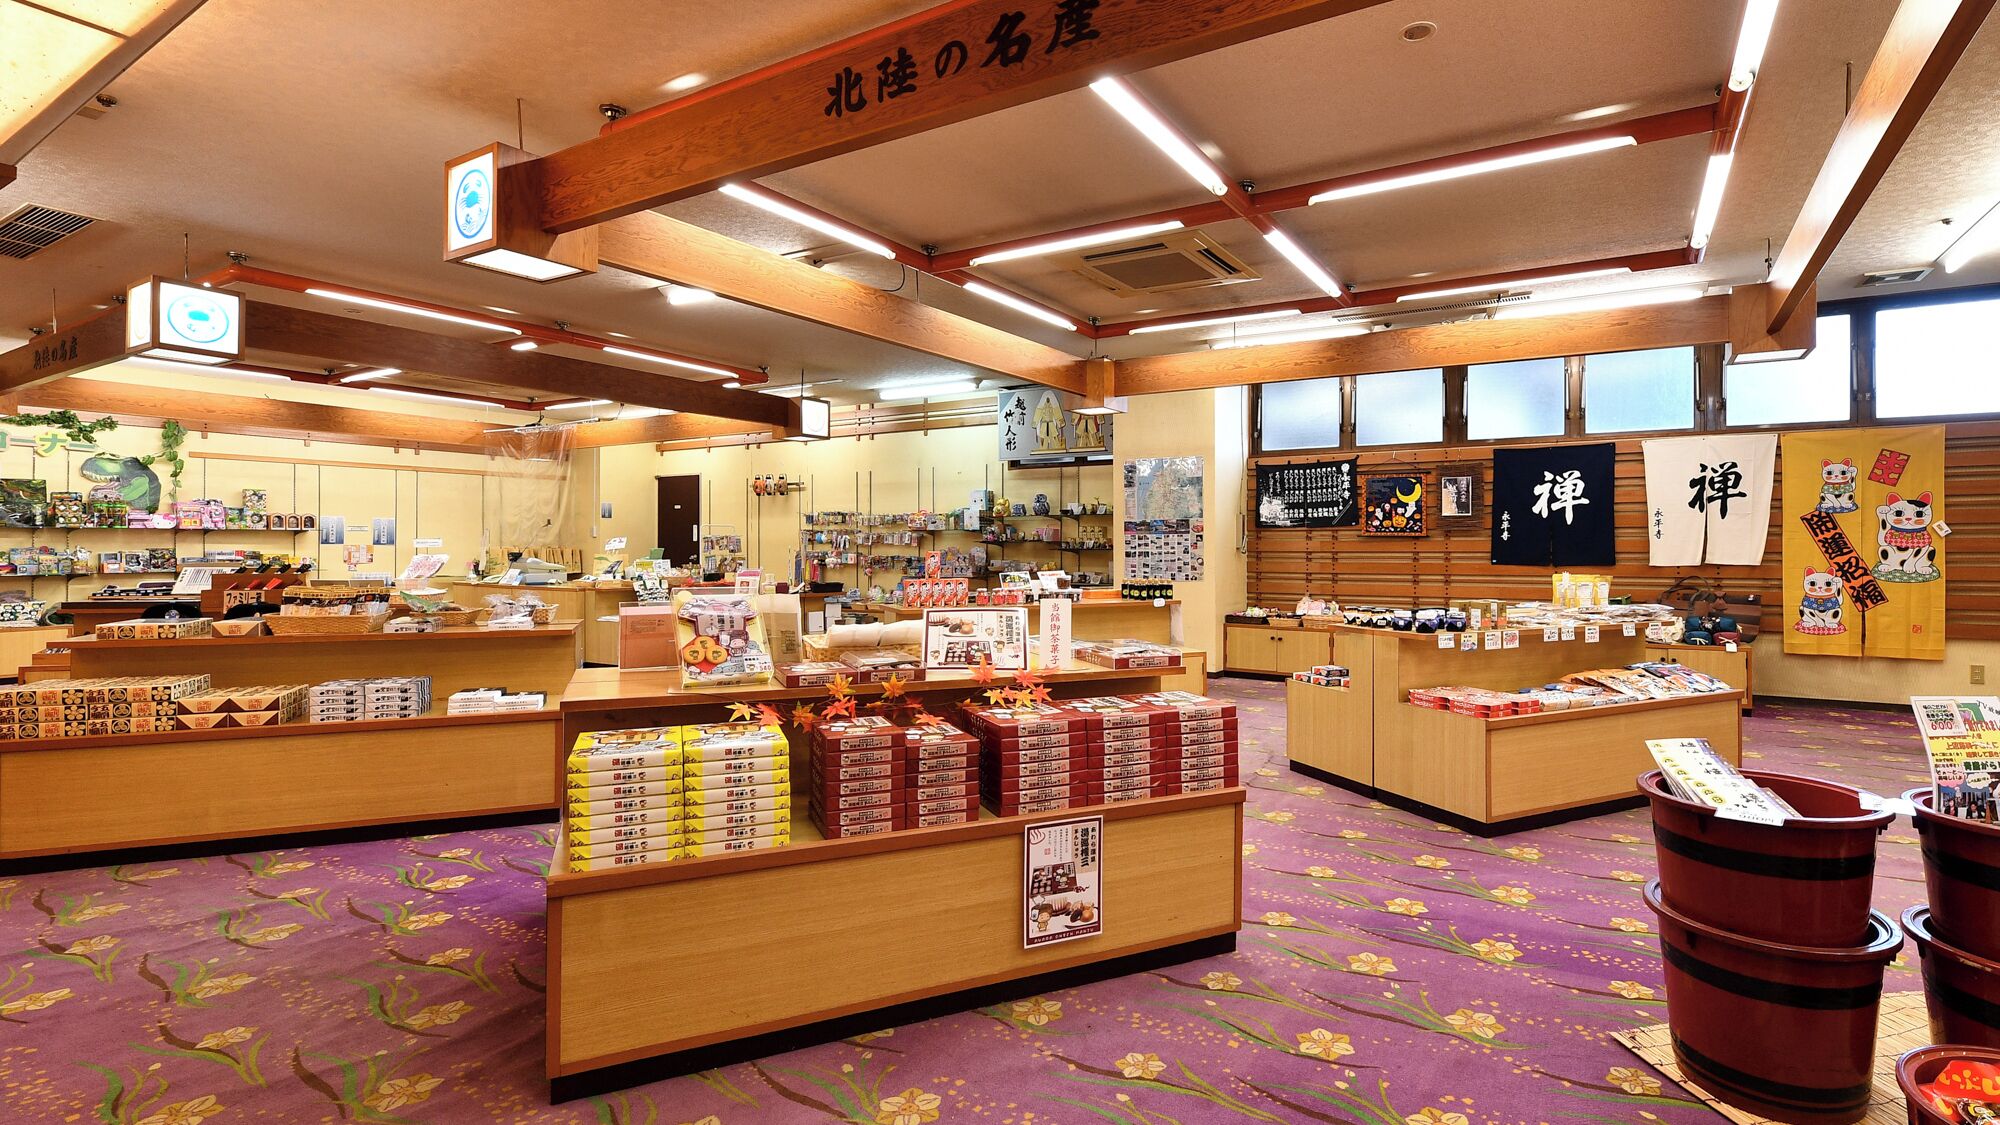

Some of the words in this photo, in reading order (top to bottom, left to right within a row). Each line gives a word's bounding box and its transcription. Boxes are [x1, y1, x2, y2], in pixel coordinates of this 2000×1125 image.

[824, 0, 1101, 118] 北陸の名産
[1004, 409, 1016, 451] 竹人形
[1531, 470, 1590, 525] 禅
[1688, 461, 1747, 519] 禅
[1500, 511, 1511, 541] 永平寺
[1653, 508, 1664, 539] 永平寺
[1802, 511, 1887, 609] 開運招福
[1049, 602, 1061, 665] 当館御茶菓子
[1931, 721, 1952, 730] 600
